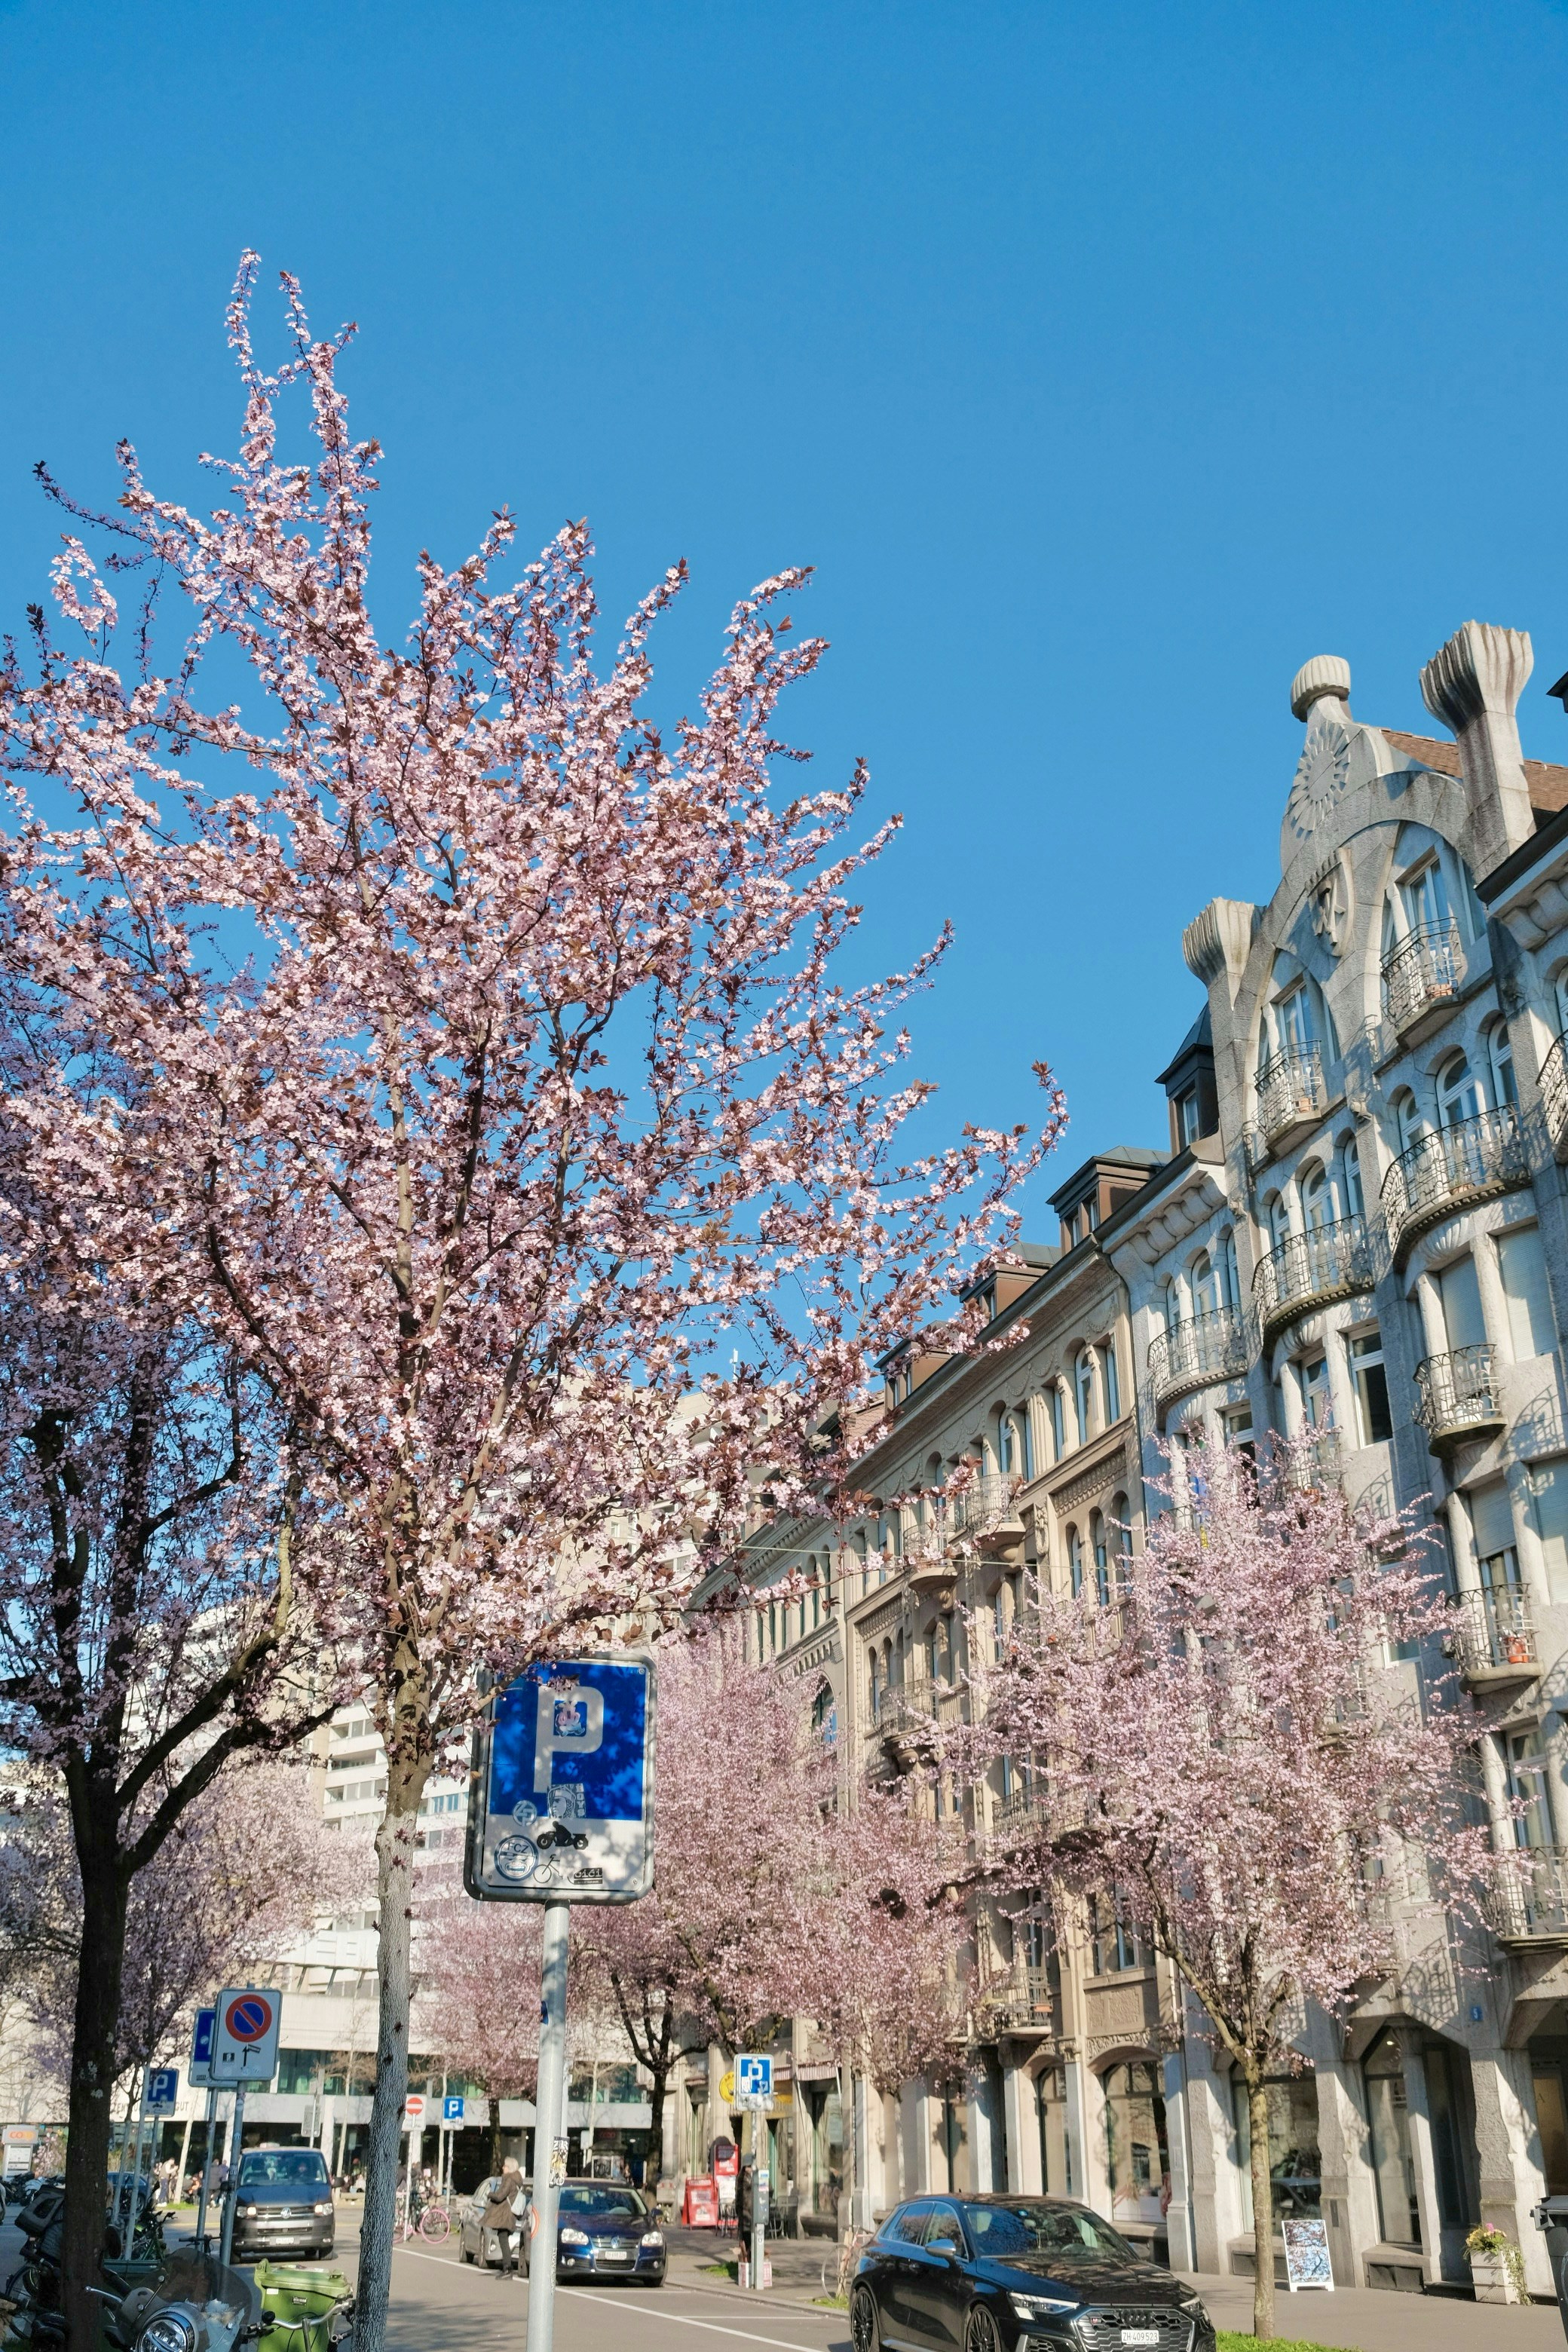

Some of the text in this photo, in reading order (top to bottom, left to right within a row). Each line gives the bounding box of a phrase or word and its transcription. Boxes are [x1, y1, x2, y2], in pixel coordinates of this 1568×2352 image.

[533, 1685, 605, 1793] P
[507, 1842, 529, 1854] FCZ
[152, 2074, 168, 2098] P
[748, 2063, 763, 2093] P
[449, 2100, 459, 2117] P
[1122, 2332, 1131, 2341] ZH
